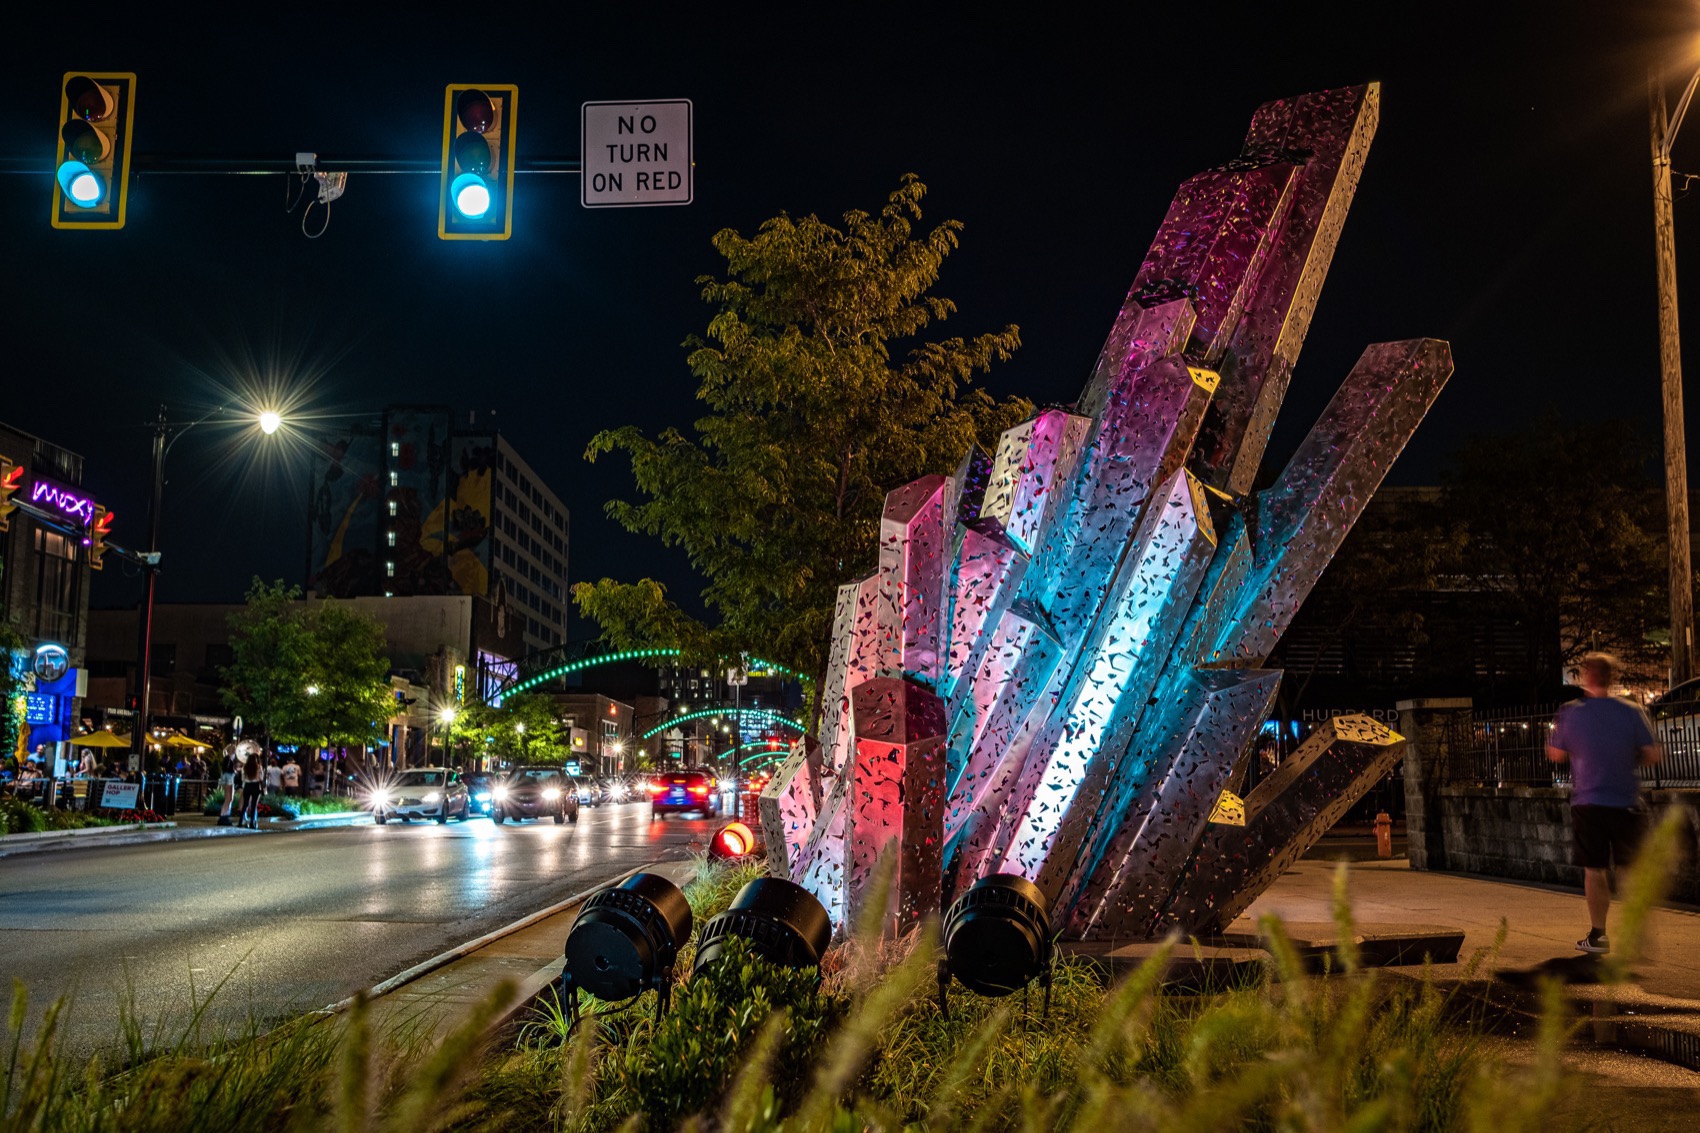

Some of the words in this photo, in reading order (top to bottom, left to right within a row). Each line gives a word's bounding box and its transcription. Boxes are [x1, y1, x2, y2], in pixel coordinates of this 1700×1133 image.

[618, 115, 657, 134] NO
[606, 143, 668, 163] TURN
[593, 173, 622, 192] ON
[636, 171, 682, 191] RED
